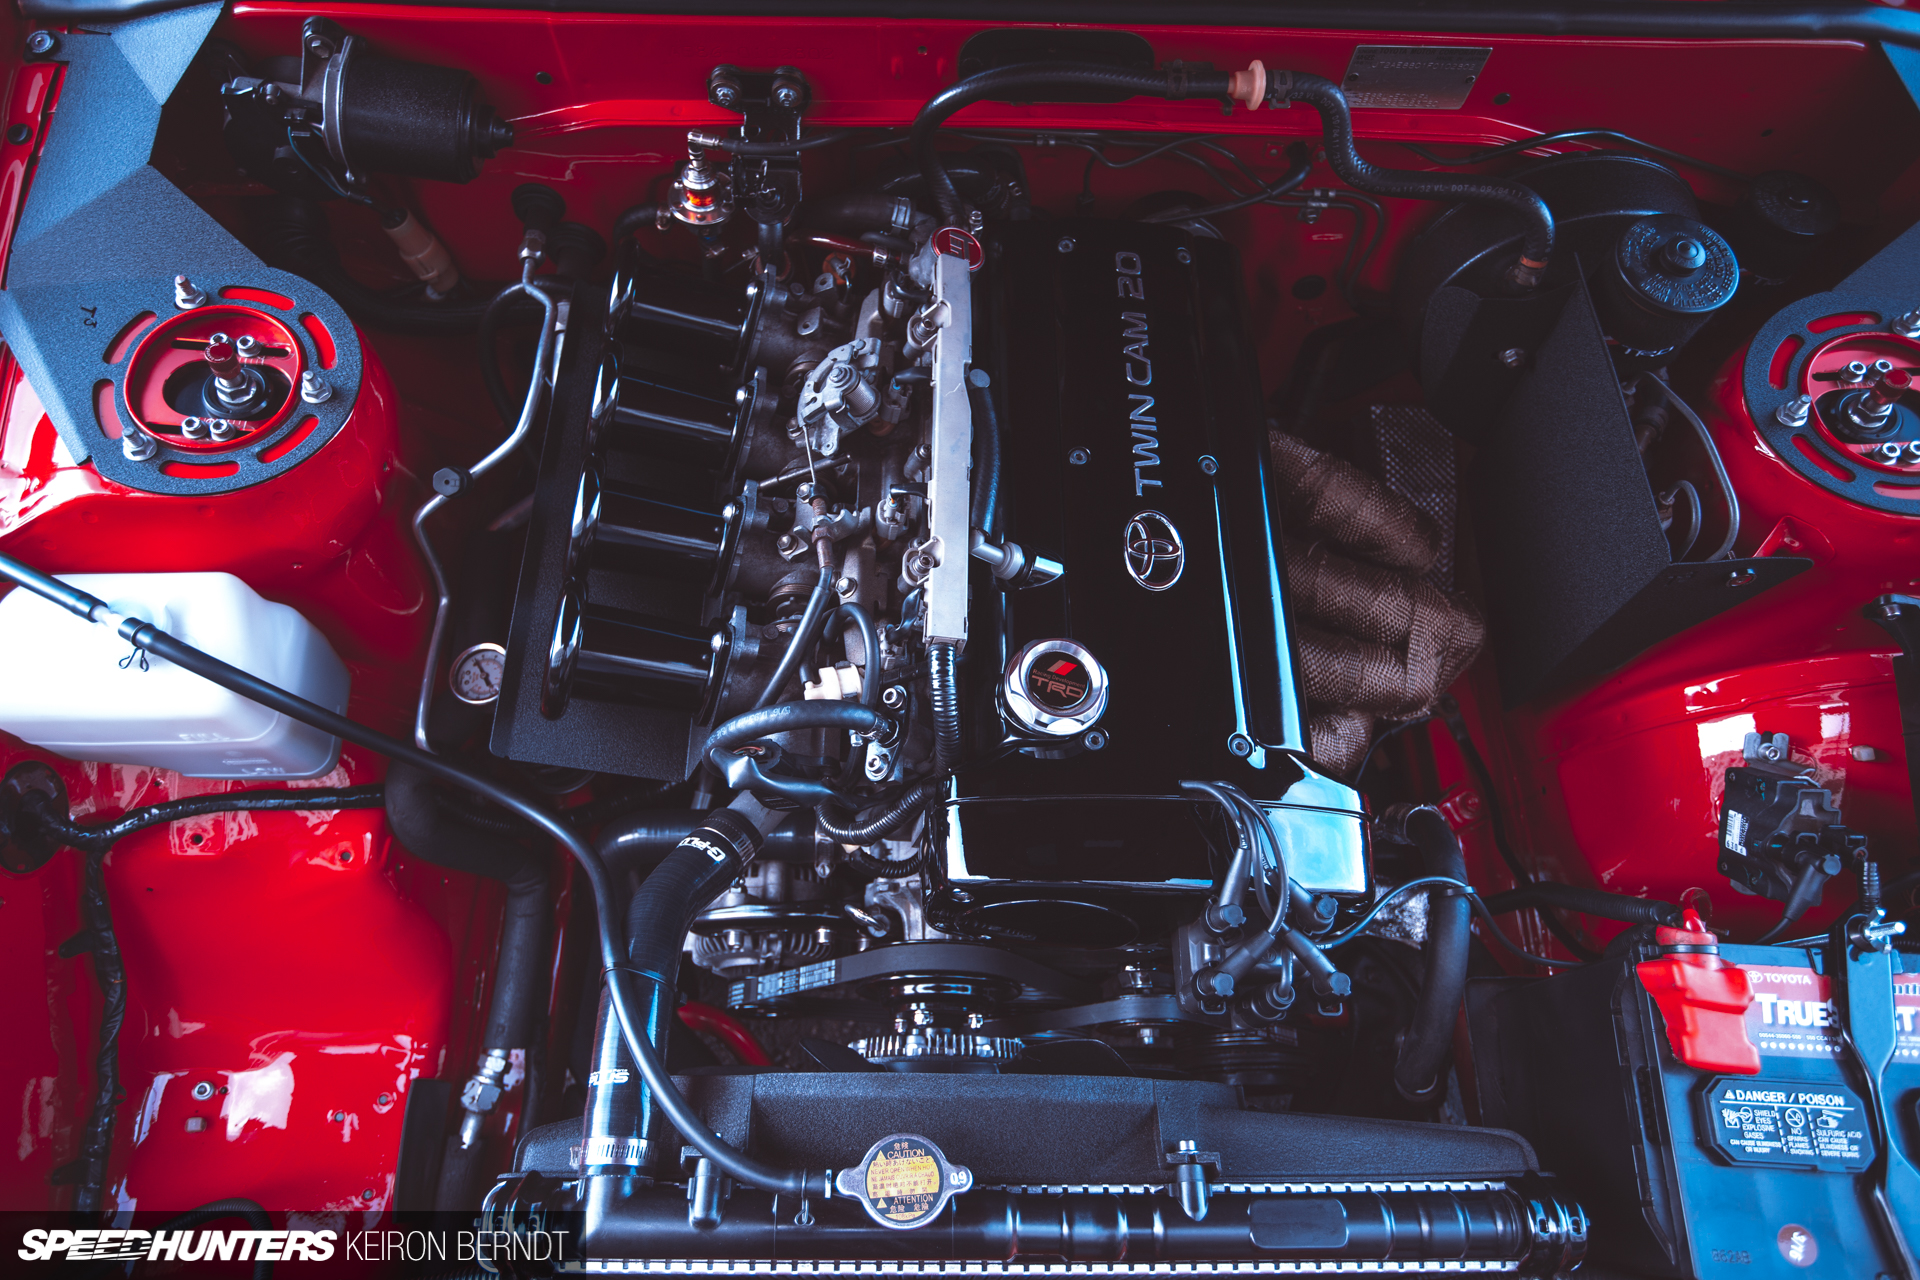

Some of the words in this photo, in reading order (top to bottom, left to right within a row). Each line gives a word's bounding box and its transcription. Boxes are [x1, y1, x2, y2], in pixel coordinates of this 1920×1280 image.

[1115, 251, 1145, 300] 20
[1121, 311, 1152, 386] CAM
[1127, 394, 1163, 497] TWIN
[1032, 668, 1052, 680] Racing
[1052, 674, 1086, 688] Development
[1032, 674, 1084, 698] TRD
[1764, 973, 1812, 985] TOYOTA
[1735, 1090, 1786, 1103] DANGER
[1798, 1093, 1845, 1106] POISON
[1753, 1109, 1776, 1117] SHIELD
[1755, 1116, 1772, 1124] EYES
[1742, 1123, 1775, 1132] EXPLOSIVE
[1791, 1127, 1802, 1135] NO
[1743, 1131, 1764, 1139] GASES
[887, 1149, 925, 1160] CAUTION
[870, 1167, 889, 1175] NEVER
[889, 1166, 905, 1174] OPEN
[905, 1164, 922, 1172] WHEN
[950, 1171, 967, 1186] 0.9
[893, 1194, 934, 1205] ATTENTION
